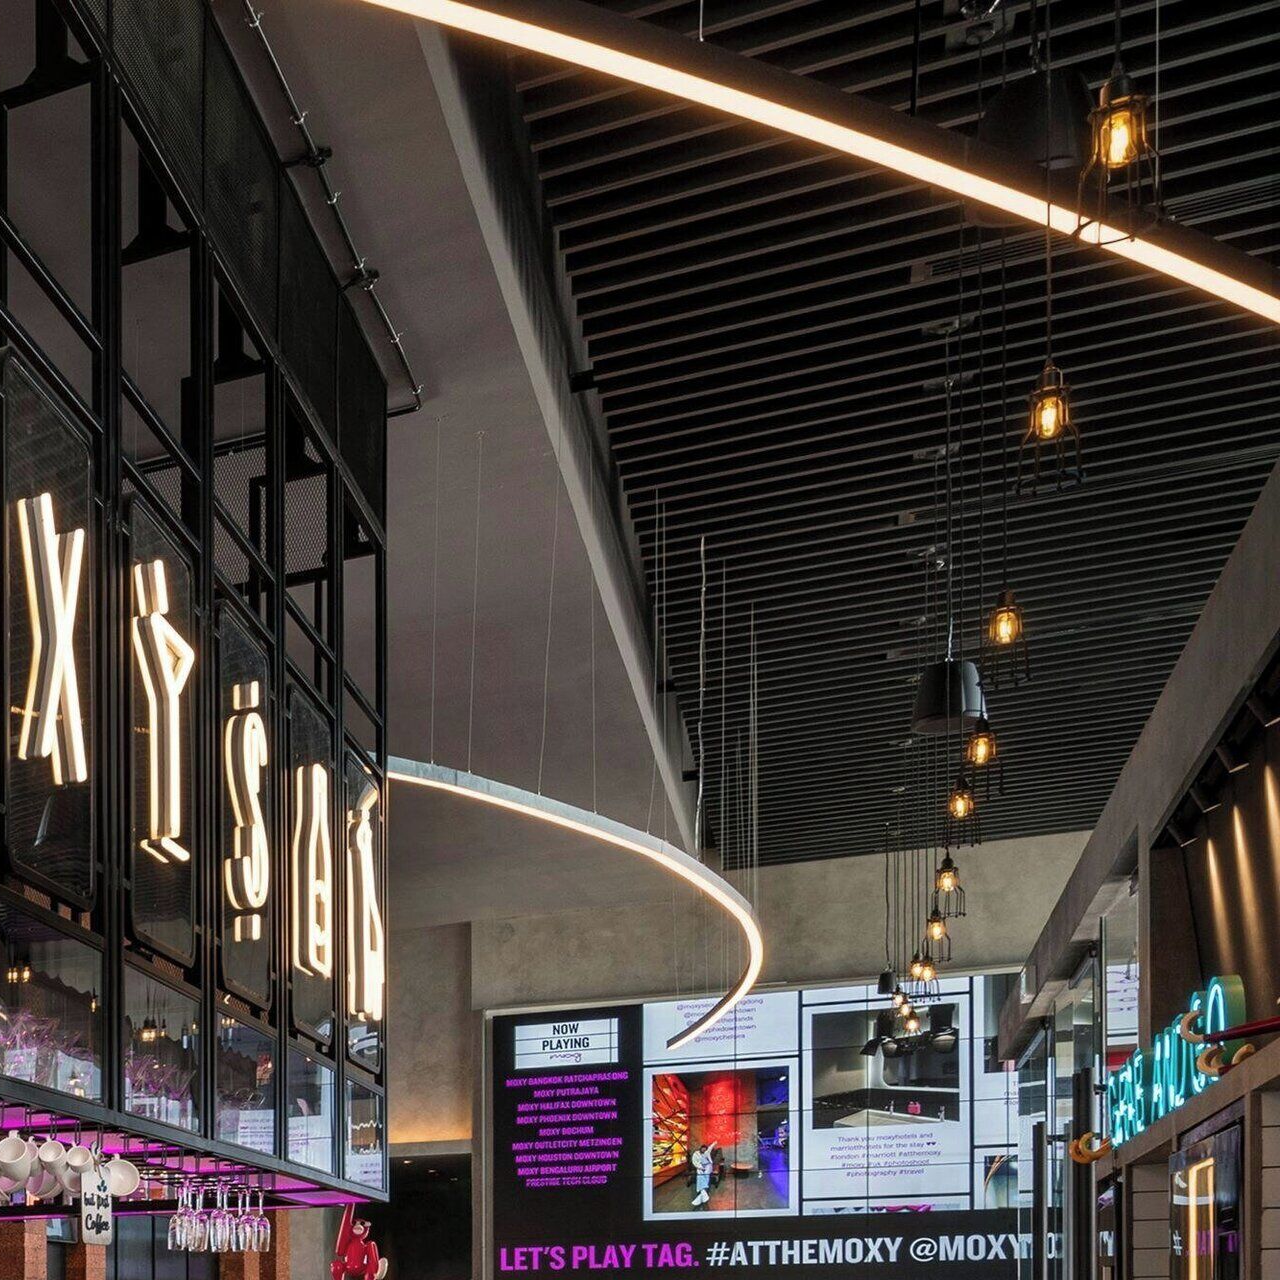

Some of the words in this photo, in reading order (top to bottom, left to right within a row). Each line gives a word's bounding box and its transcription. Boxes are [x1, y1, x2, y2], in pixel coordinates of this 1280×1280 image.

[552, 1023, 580, 1036] NOW
[542, 1037, 590, 1051] PLAYING
[506, 1078, 527, 1087] MOXY
[528, 1075, 563, 1086] BANGKOK
[533, 1089, 555, 1098] MOXY
[556, 1087, 599, 1097] PUTRAJAYA
[517, 1103, 539, 1112] MOXY
[540, 1101, 571, 1110] HALIFAX
[571, 1098, 617, 1109] DOWNTOWN
[516, 1116, 539, 1125] MOXY
[539, 1114, 572, 1123] PHOENIX
[572, 1111, 618, 1121] DOWNTOWN
[538, 1128, 561, 1136] MOXY
[838, 1135, 861, 1143] Thank
[896, 1141, 908, 1149] the
[909, 1141, 925, 1149] stay
[512, 1142, 534, 1151] MOXY
[515, 1154, 537, 1163] MOXY
[537, 1152, 573, 1162] HOUSTON
[573, 1150, 620, 1160] DOWNTOWN
[898, 1149, 942, 1158] #atthemoxy
[517, 1167, 539, 1176] MOXY
[540, 1165, 584, 1175] BENGALURU
[584, 1163, 617, 1173] AIRPORT
[846, 1169, 898, 1178] #photography
[899, 1168, 925, 1176] #travel
[500, 1245, 566, 1272] LET'S
[572, 1244, 637, 1270] PLAY
[641, 1242, 700, 1269] TAG.
[705, 1236, 904, 1267] #ATTHEMOXY
